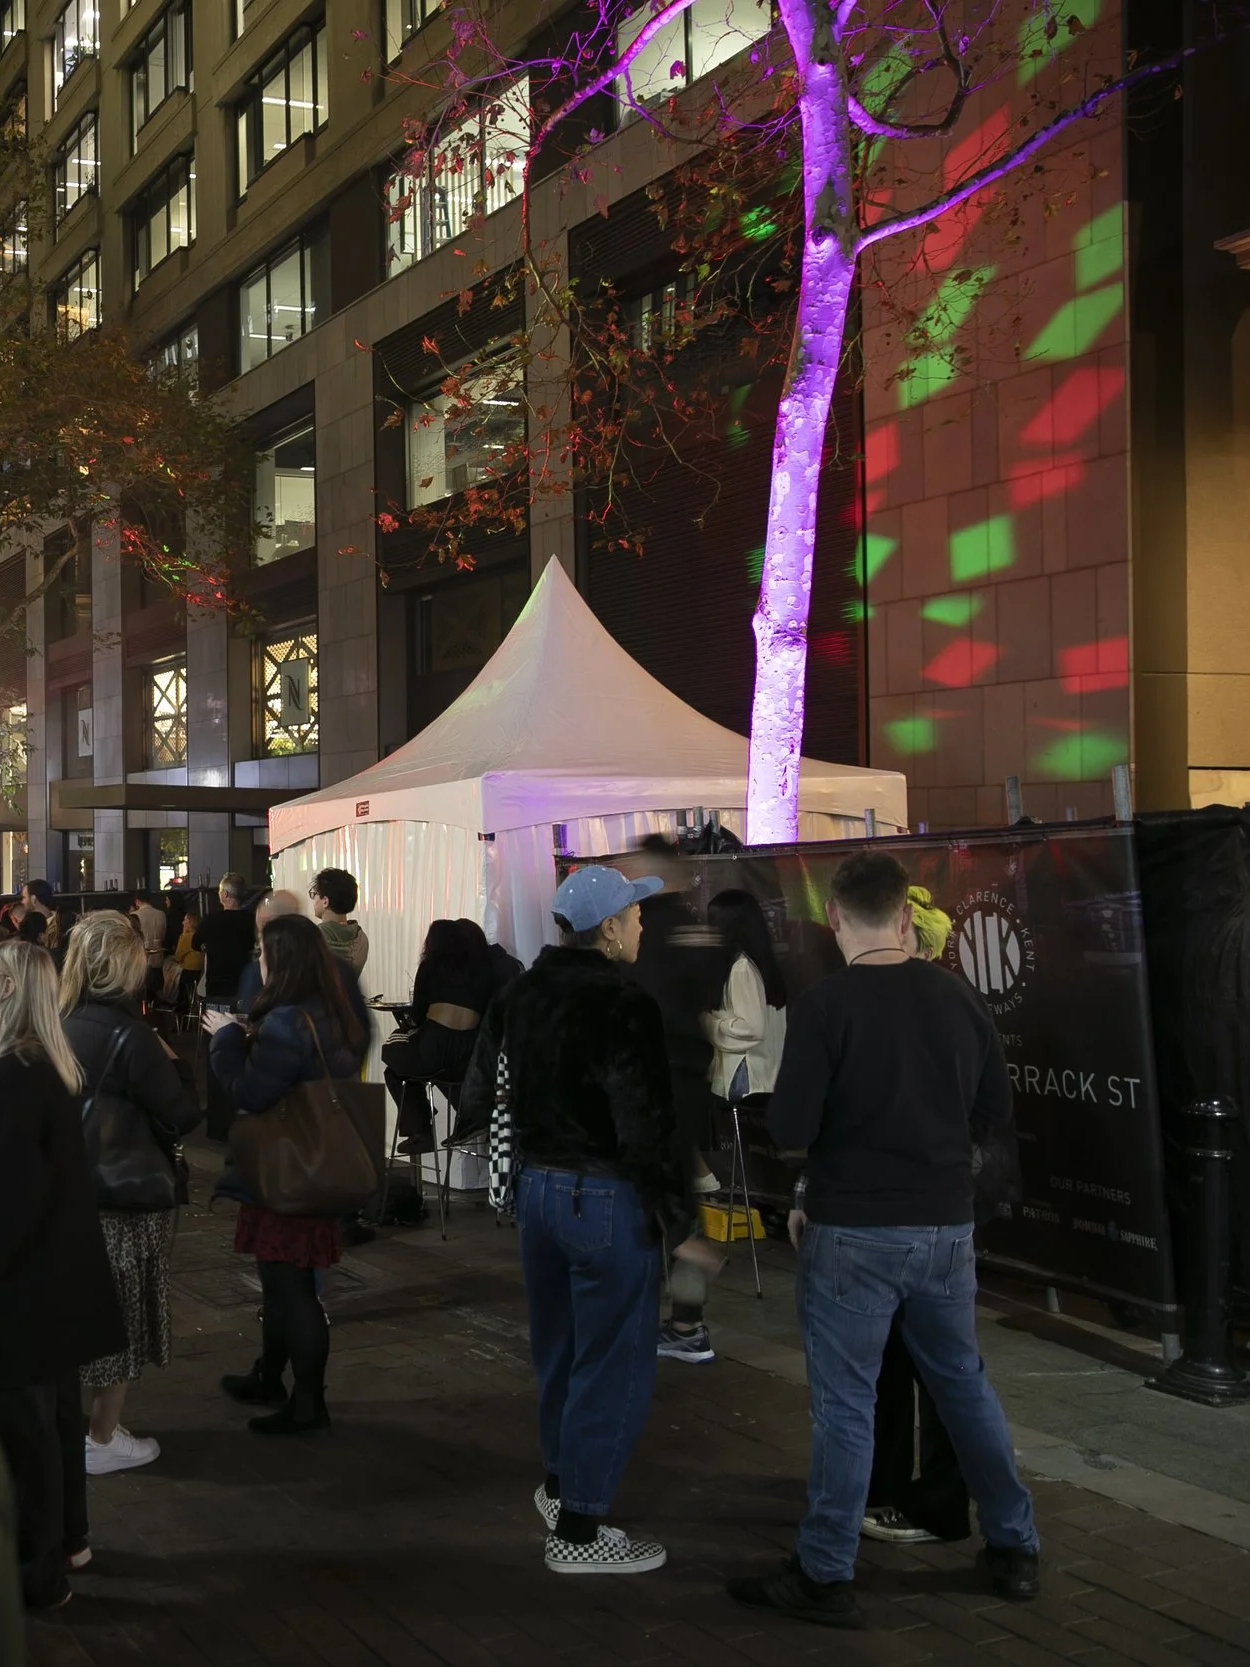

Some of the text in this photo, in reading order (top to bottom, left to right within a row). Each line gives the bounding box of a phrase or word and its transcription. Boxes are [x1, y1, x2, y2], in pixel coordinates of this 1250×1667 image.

[955, 890, 1015, 916] CLARENCE
[1020, 927, 1036, 972] KENT
[1006, 1063, 1141, 1110] RRACK ST
[1050, 1175, 1132, 1206] OUR PARTNERS
